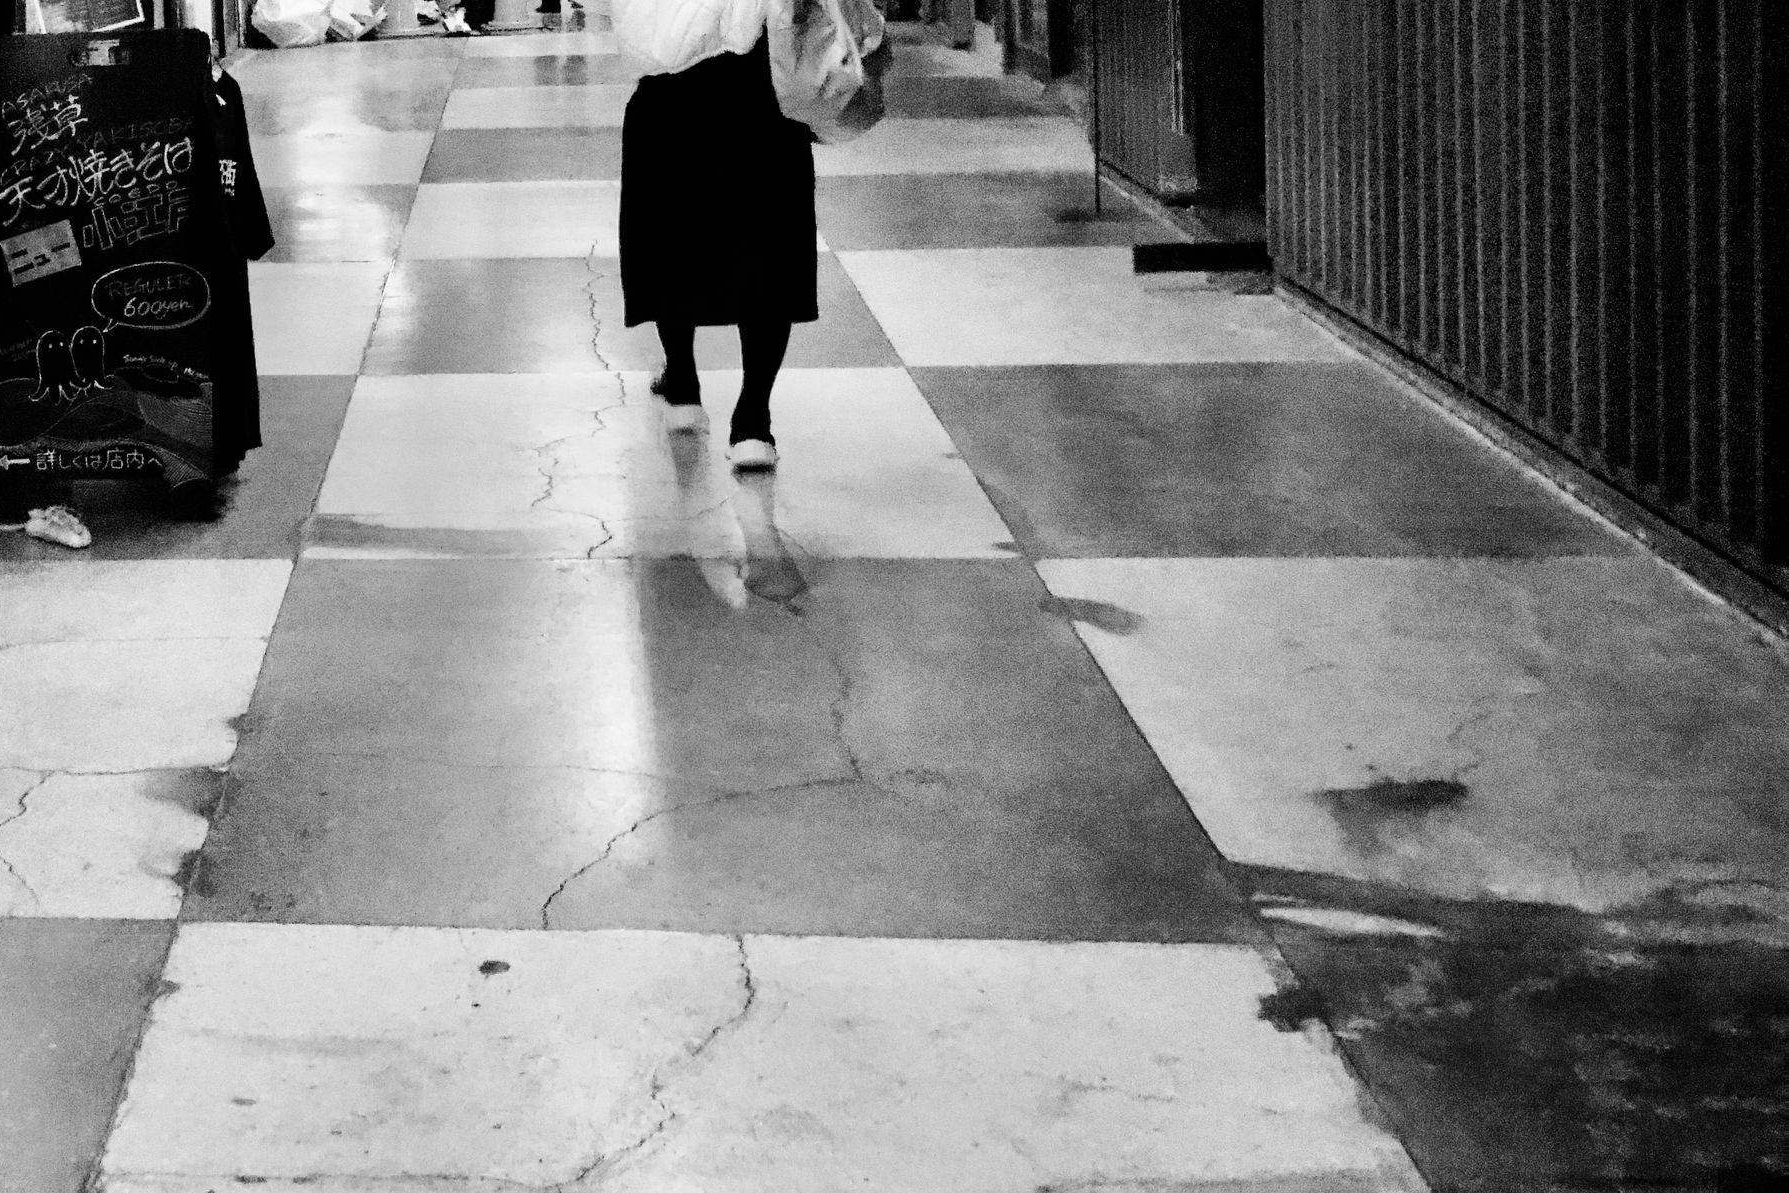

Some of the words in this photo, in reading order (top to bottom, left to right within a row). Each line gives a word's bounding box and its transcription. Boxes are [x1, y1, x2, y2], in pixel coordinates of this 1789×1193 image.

[36, 448, 163, 471] 詳しくは店内へ
